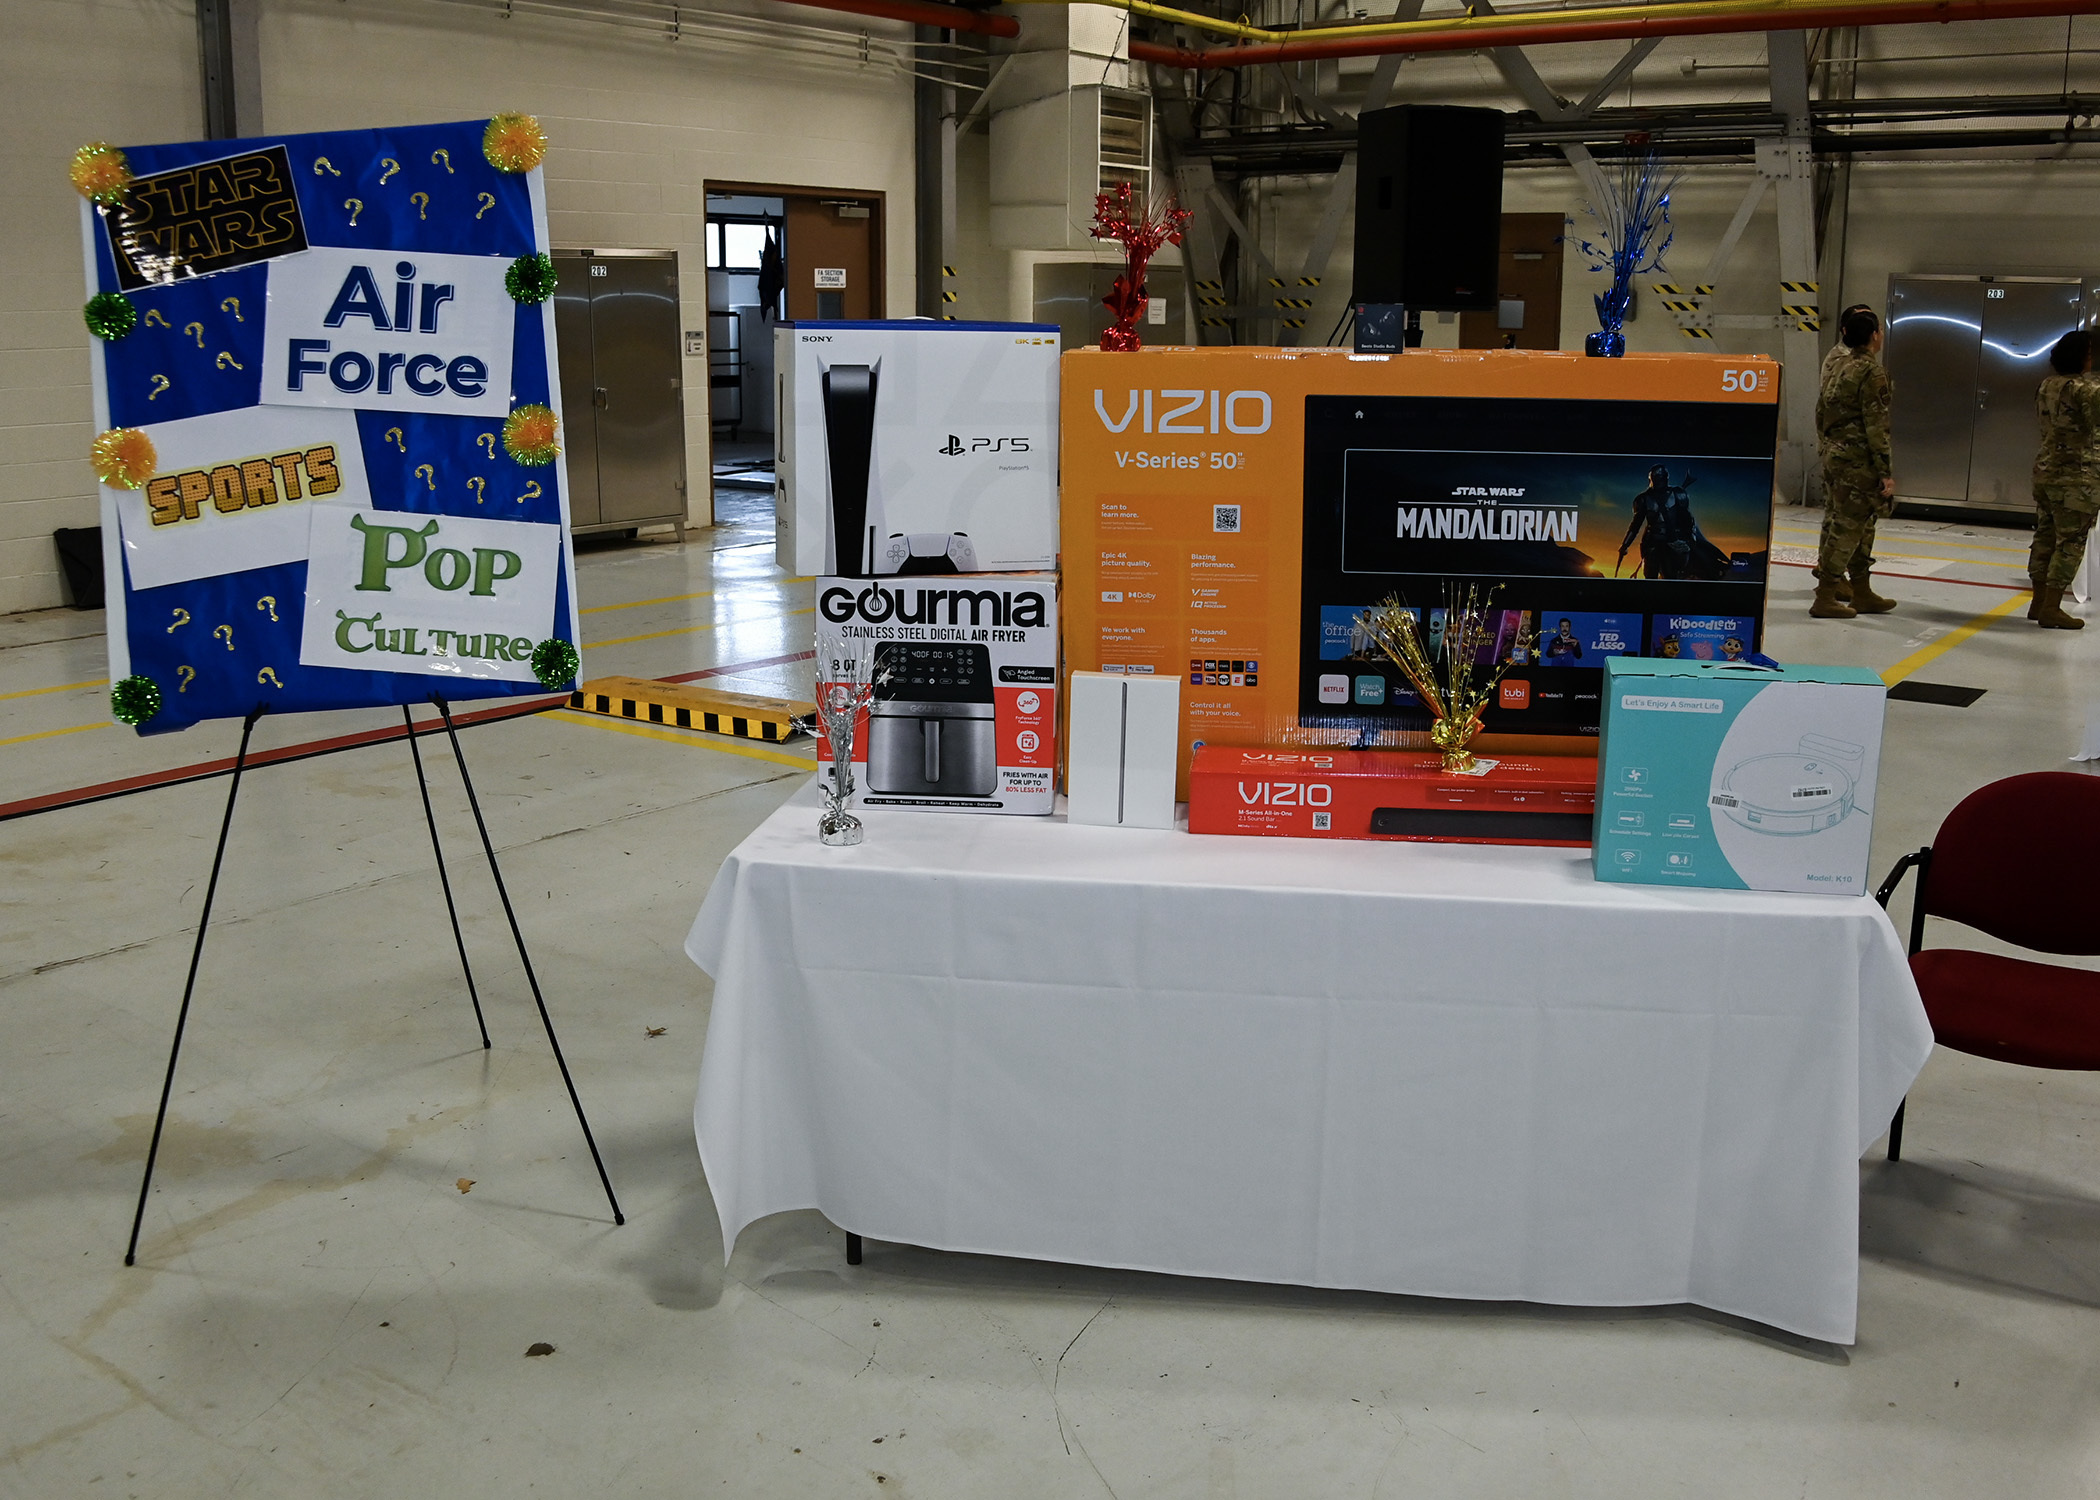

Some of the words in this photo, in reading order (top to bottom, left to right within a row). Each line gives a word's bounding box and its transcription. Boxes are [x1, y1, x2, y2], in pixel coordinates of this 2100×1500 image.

[118, 155, 283, 227] STAR
[115, 198, 296, 275] WARS
[591, 266, 607, 276] 202
[322, 260, 455, 335] Air
[1988, 290, 2003, 298] 203
[801, 335, 834, 343] SONY
[286, 337, 490, 398] Force
[1093, 388, 1273, 435] VIZIO
[971, 437, 1030, 453] PS5
[147, 445, 341, 527] SPORTS
[1451, 486, 1489, 496] STAR
[1489, 487, 1526, 497] WARS
[1101, 503, 1118, 511] Scan
[1119, 503, 1127, 511] to
[1396, 507, 1579, 542] MANDALORIAN
[1101, 551, 1116, 560] Epic
[1191, 553, 1217, 561] Blazing
[1137, 591, 1157, 600] Dolby
[819, 581, 1046, 628] Gourmia
[841, 625, 895, 640] STAINLESS
[897, 626, 927, 641] STEEL
[930, 627, 968, 642] DIGITAL
[970, 629, 989, 642] AIR
[992, 630, 1026, 643] FRYER
[1324, 625, 1361, 637] office
[1694, 632, 1725, 640] Streaming
[1599, 633, 1619, 642] TED
[1591, 641, 1626, 651] LASSO
[911, 650, 930, 658] 400F
[832, 658, 840, 671] 8
[843, 658, 856, 672] QT
[1504, 687, 1525, 698] tubi
[1189, 701, 1215, 709] Control
[1624, 698, 1645, 706] Let's
[1646, 699, 1669, 709] Enjoy
[1670, 700, 1677, 708] A
[1678, 701, 1703, 709] Smart
[1704, 702, 1720, 710] Life
[1242, 752, 1334, 763] VIZIO
[1238, 781, 1332, 807] VIZIO
[1806, 874, 1833, 882] Model:
[1835, 875, 1853, 883] K10
